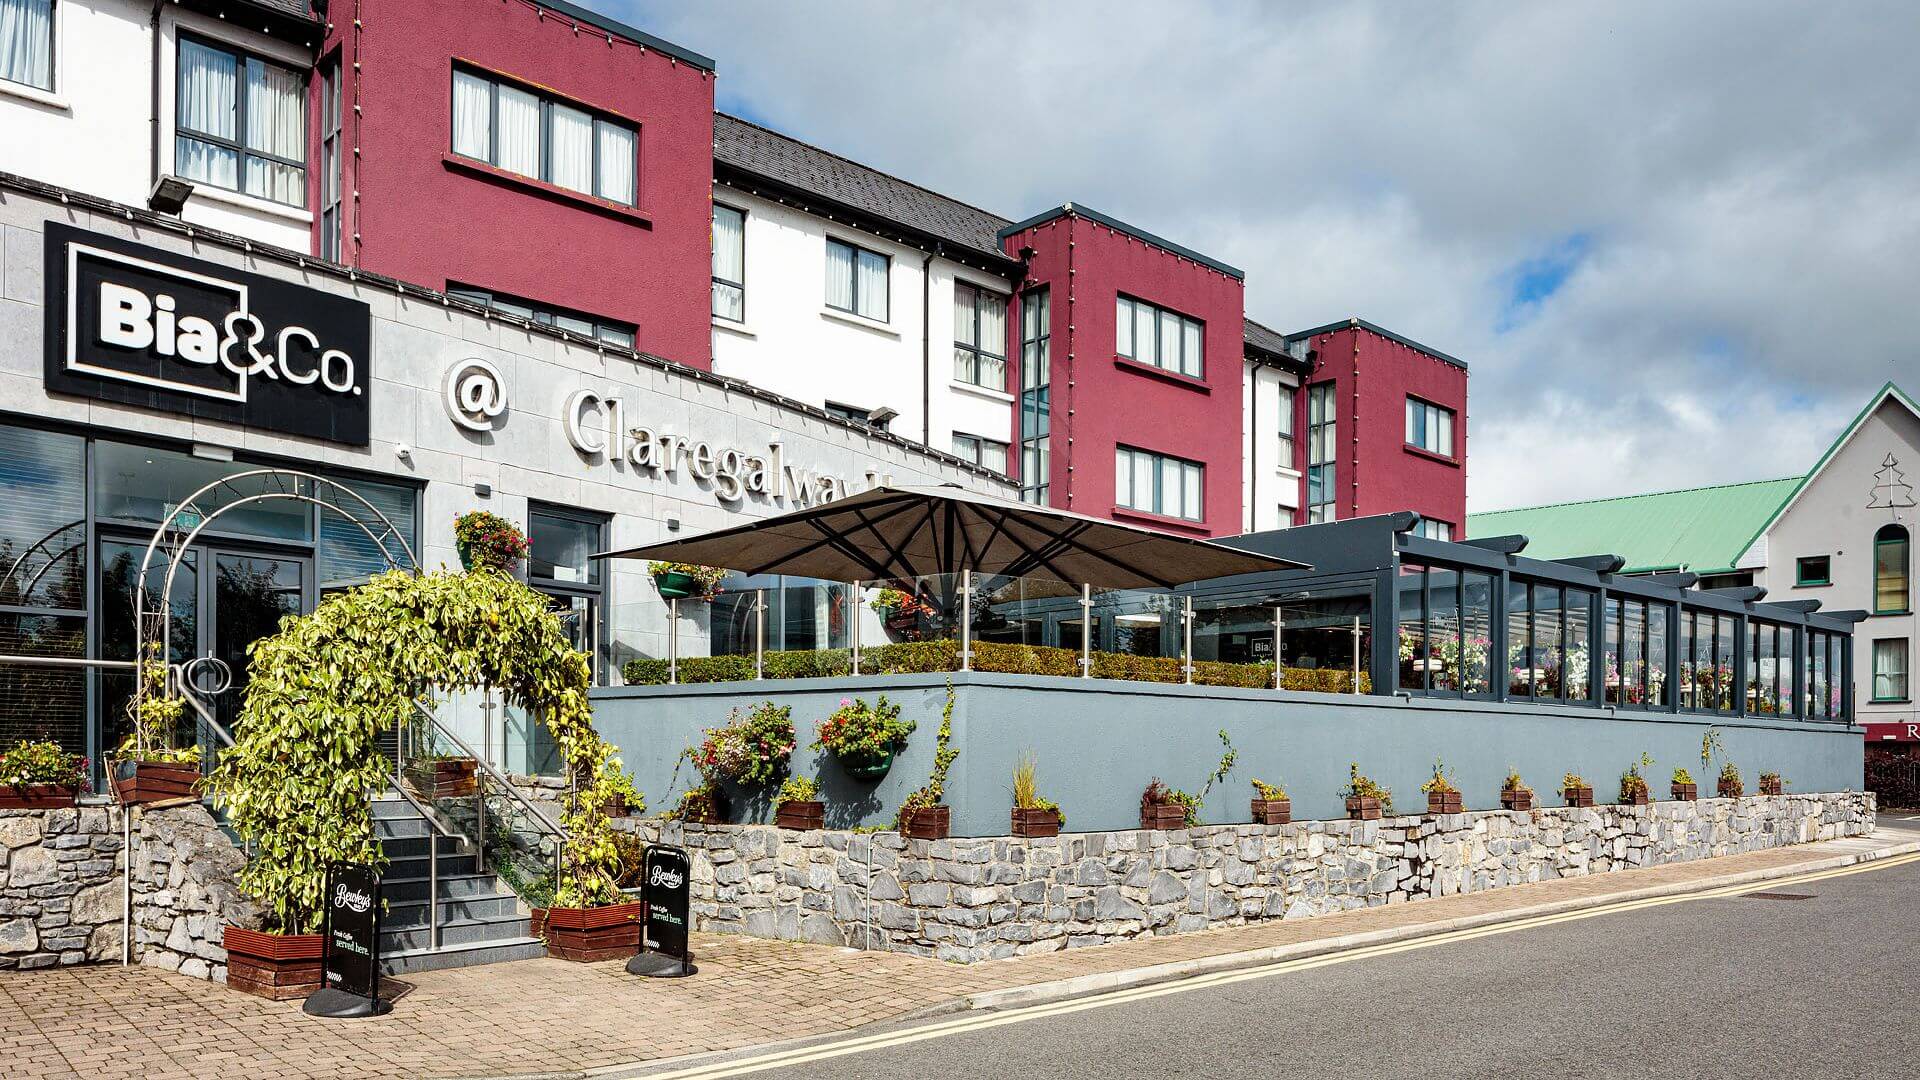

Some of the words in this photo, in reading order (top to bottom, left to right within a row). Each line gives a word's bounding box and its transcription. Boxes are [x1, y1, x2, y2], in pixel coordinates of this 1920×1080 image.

[100, 281, 362, 396] Bia&Co.
[442, 357, 507, 432] @
[335, 884, 371, 912] Bewley's
